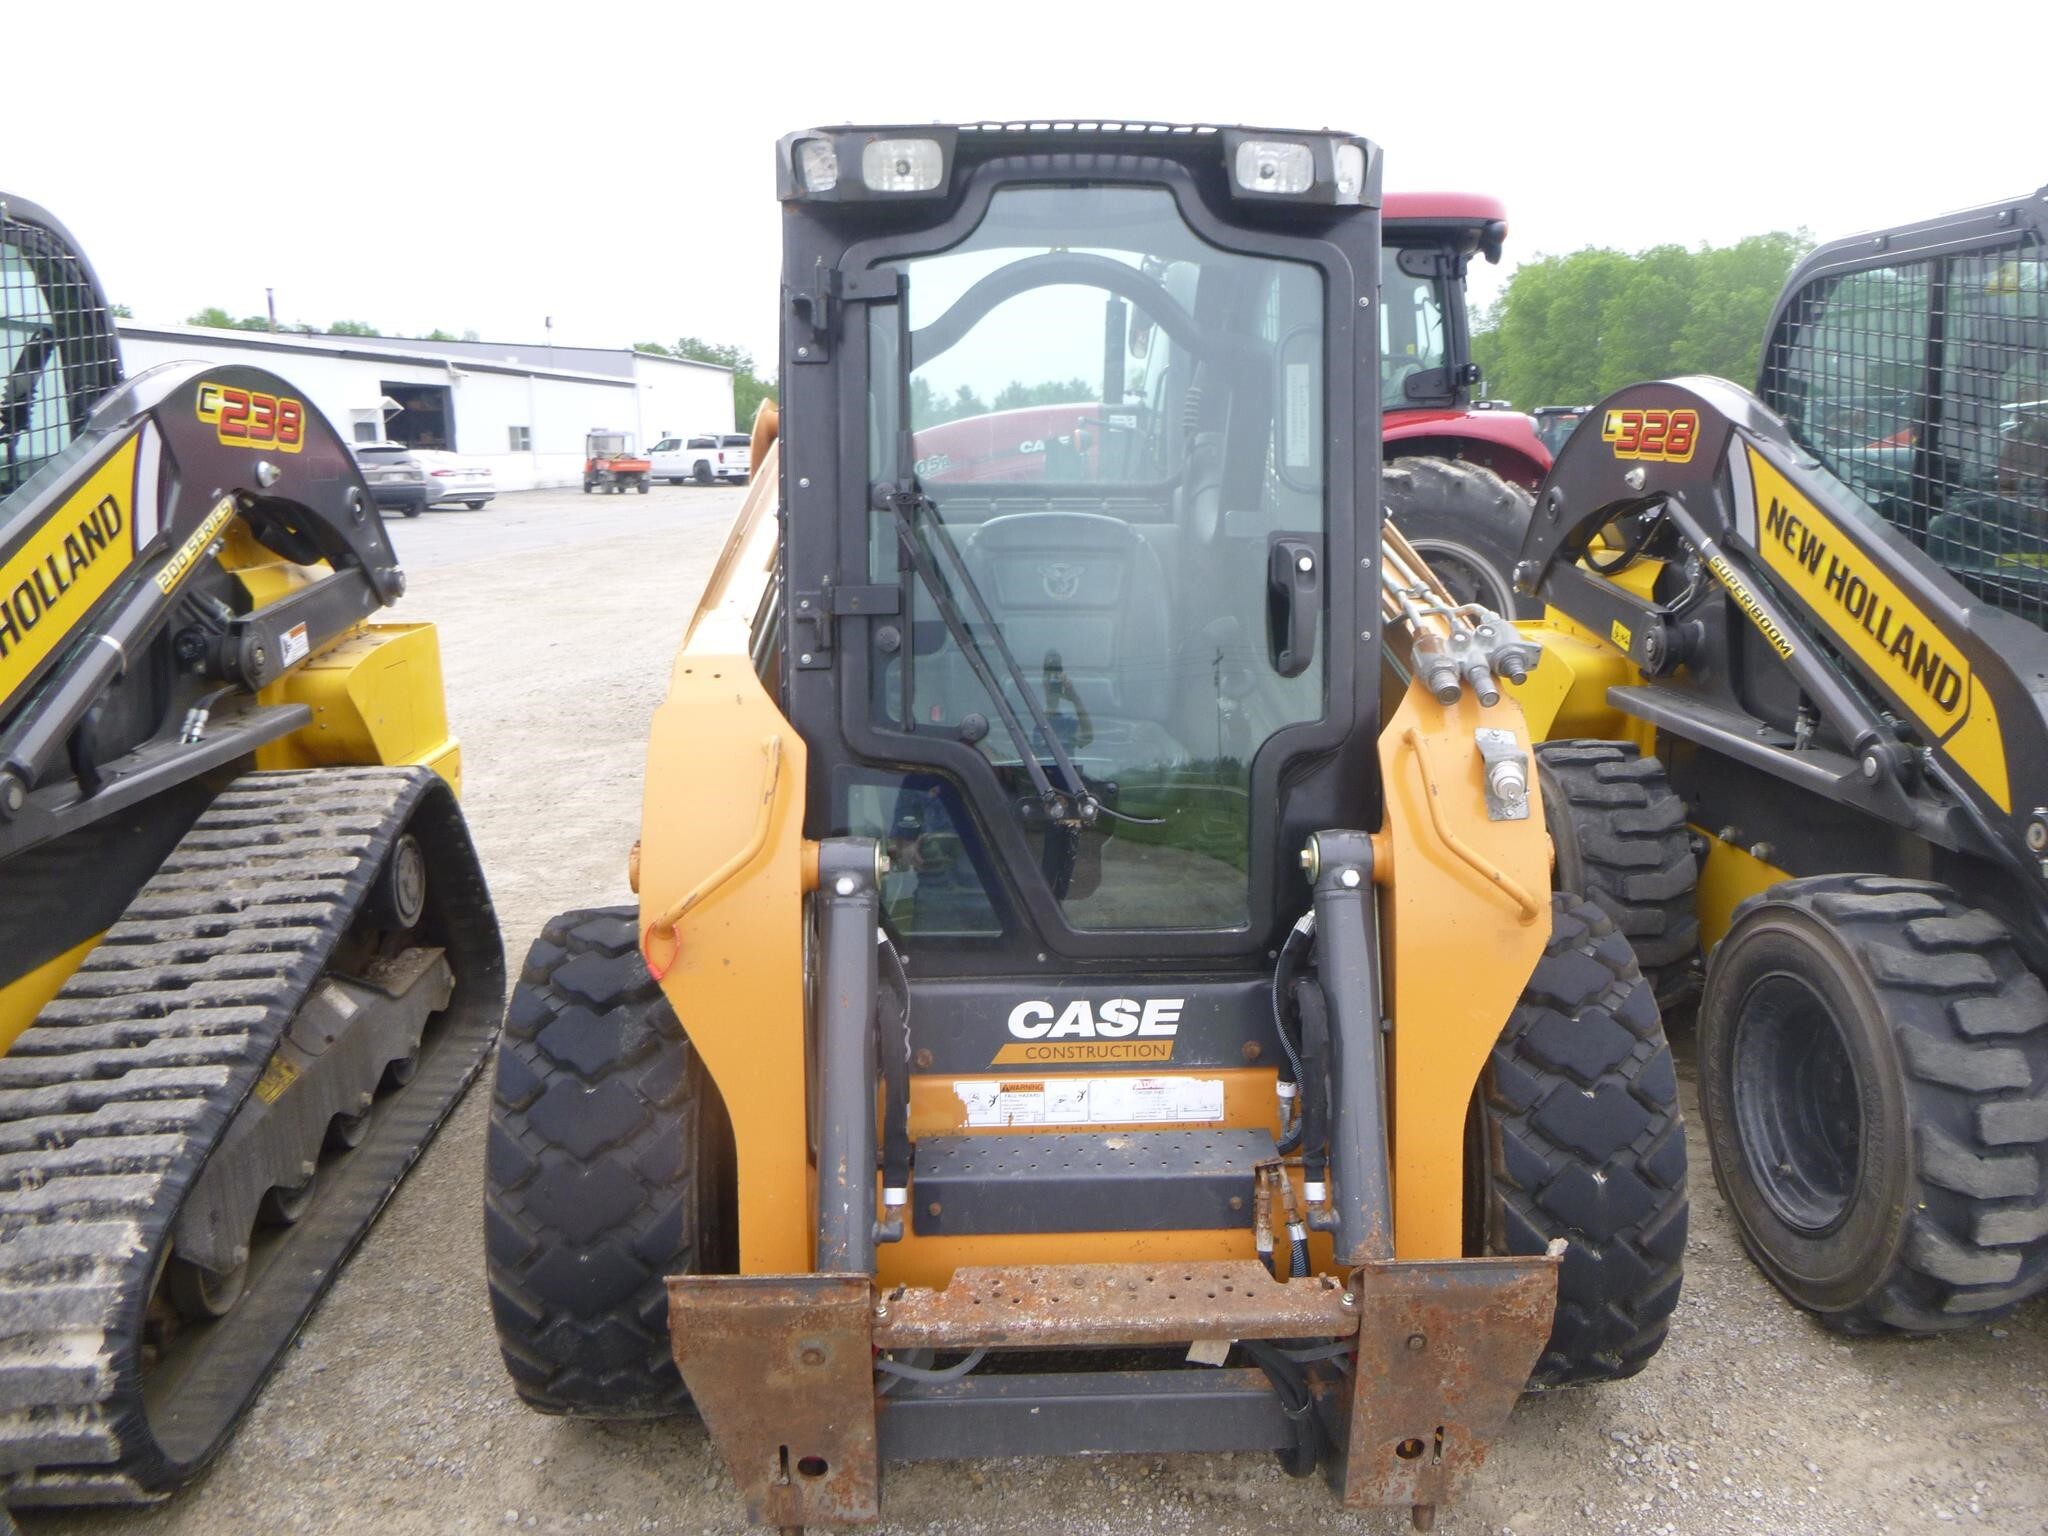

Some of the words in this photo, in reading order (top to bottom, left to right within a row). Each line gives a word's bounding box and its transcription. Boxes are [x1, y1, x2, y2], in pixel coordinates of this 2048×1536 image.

[199, 386, 302, 446] C238
[1604, 412, 1697, 456] L328
[0, 494, 123, 660] HOLLAND
[158, 552, 188, 590] 200
[187, 502, 231, 556] SERIES
[1709, 556, 1753, 610] SUPER
[1750, 604, 1793, 656] BOOM
[1765, 496, 1826, 576] NEW
[1824, 554, 1962, 713] HOLLAND
[1007, 998, 1185, 1040] CASE
[1025, 1044, 1167, 1060] CONSTRUCTION
